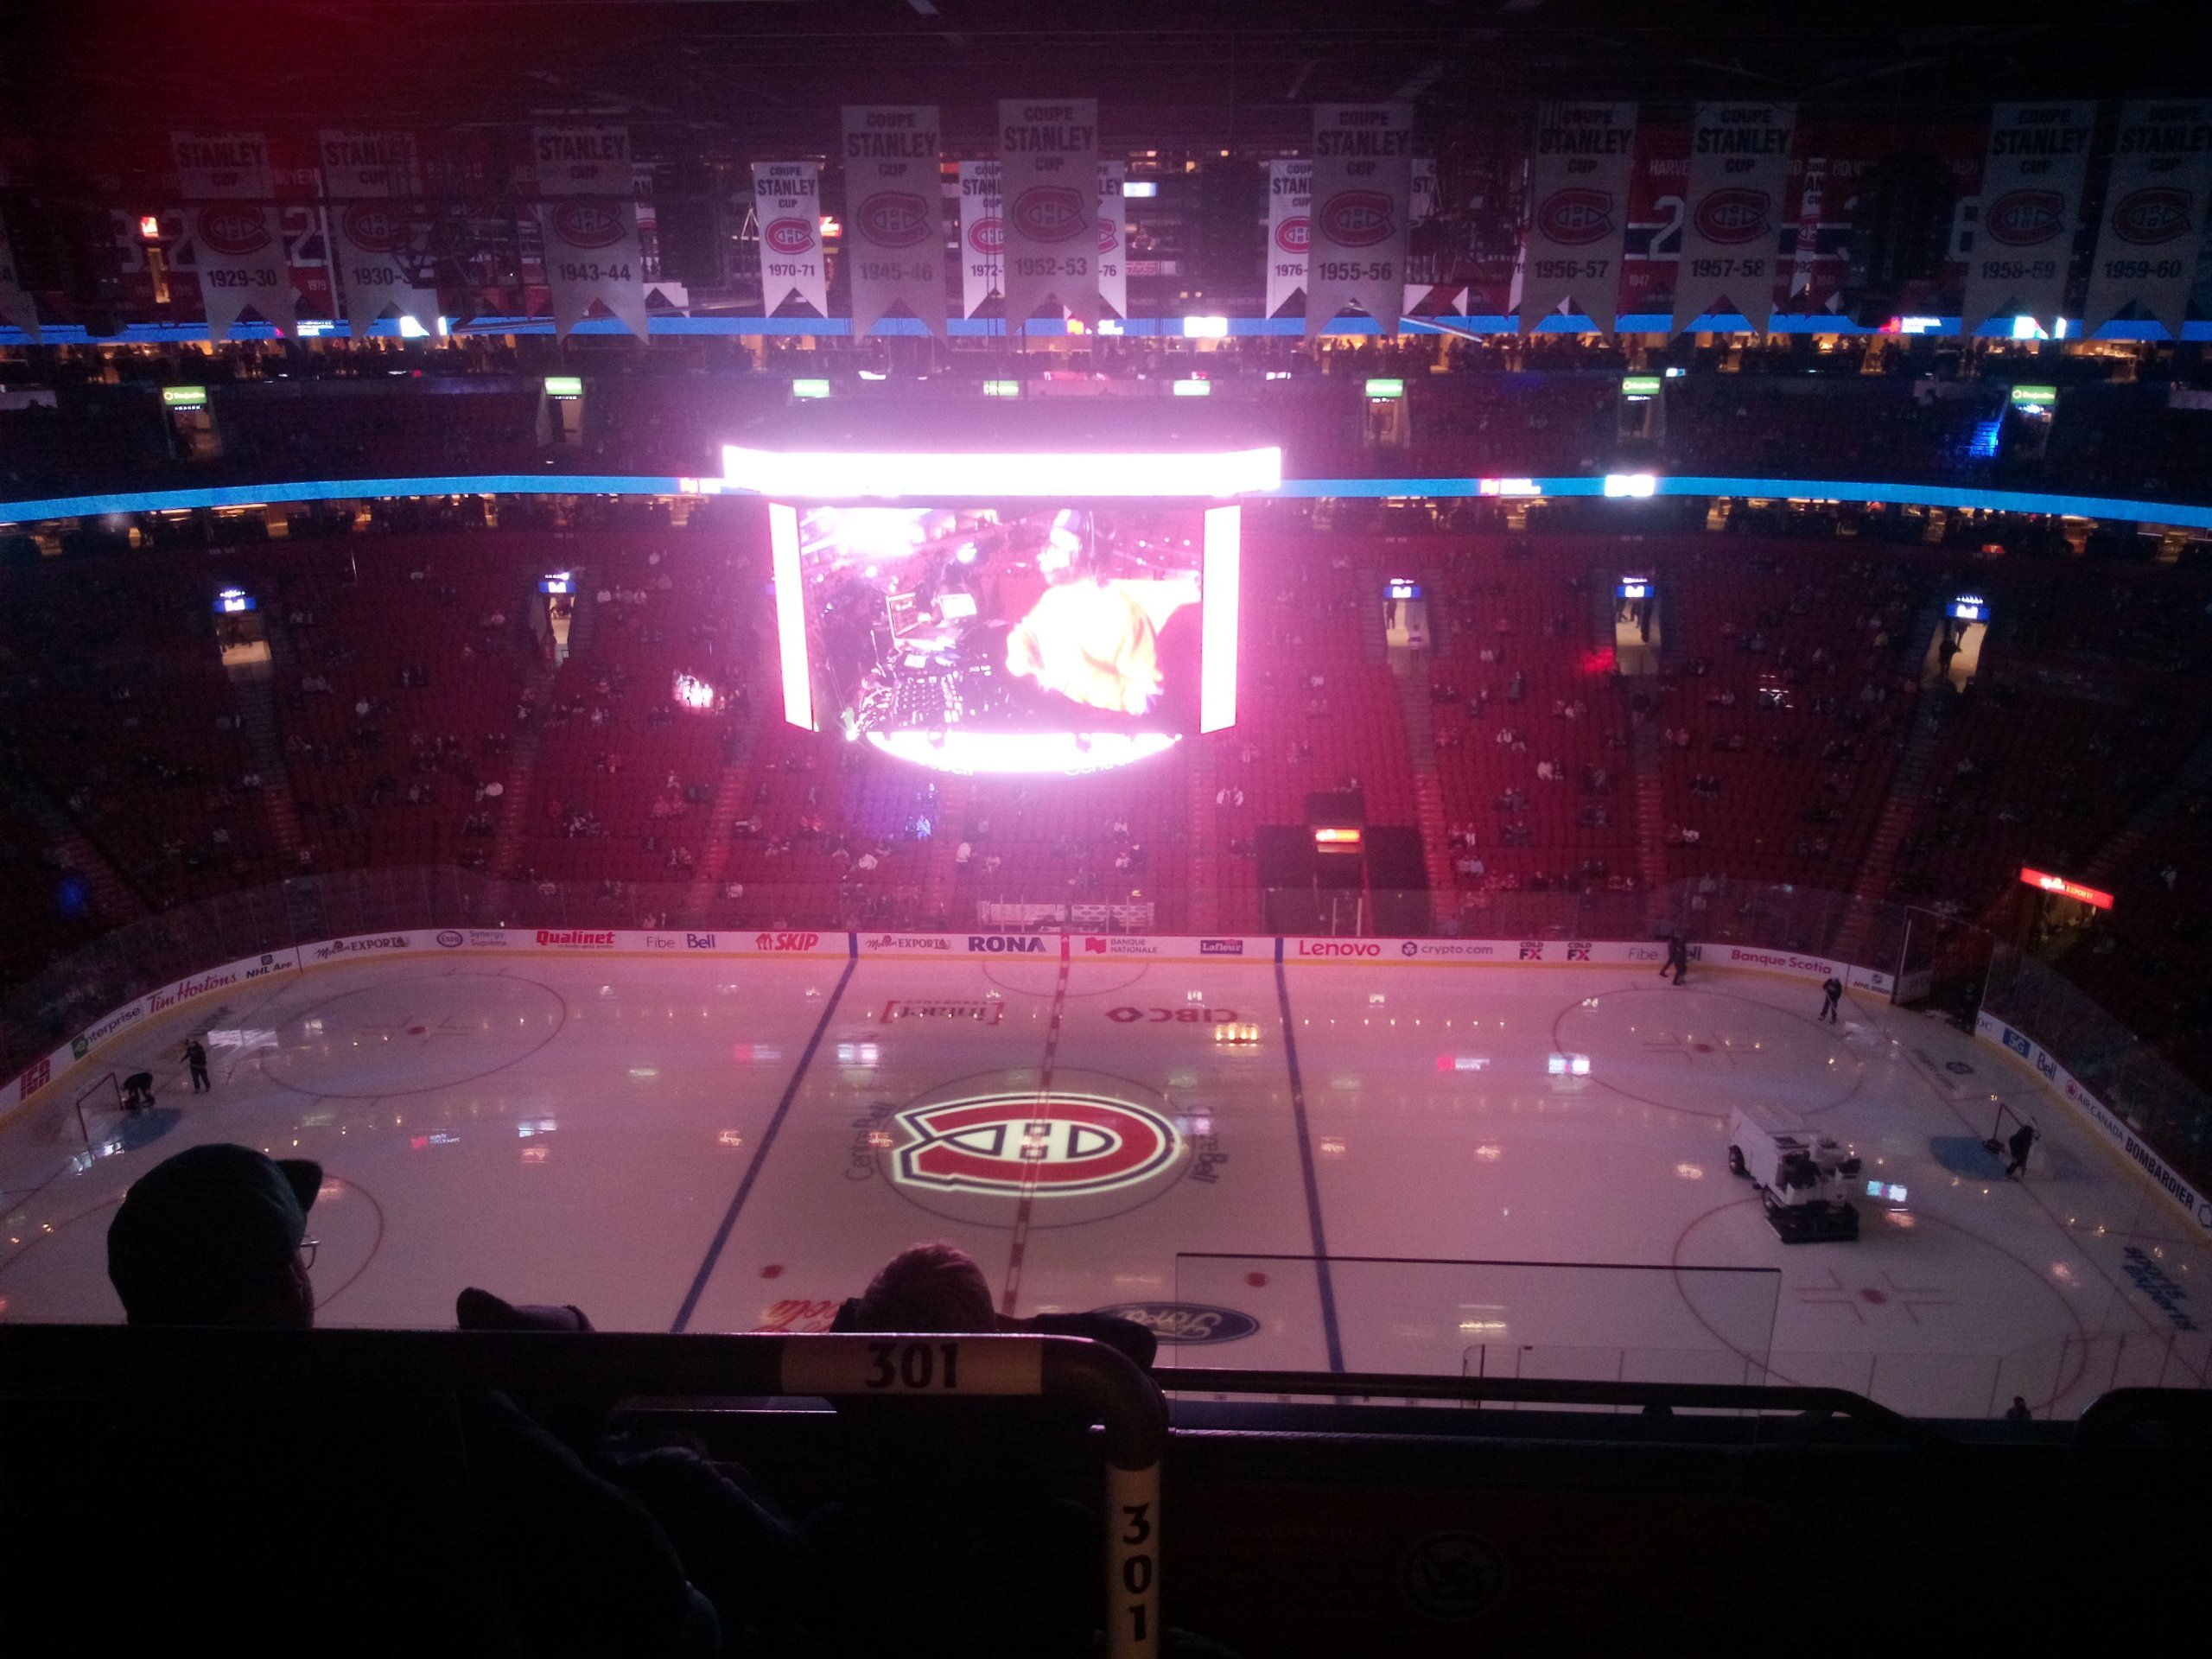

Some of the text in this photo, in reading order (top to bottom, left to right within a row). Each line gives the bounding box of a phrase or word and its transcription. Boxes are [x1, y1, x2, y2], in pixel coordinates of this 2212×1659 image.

[867, 113, 916, 128] COUPE
[1023, 107, 1074, 123] COUPE
[1339, 111, 1389, 126] COUPE
[846, 132, 937, 158] STANLEY
[1004, 126, 1095, 152] STANLEY
[1316, 130, 1408, 156] STANLEY
[1538, 129, 1632, 155] STANLEY
[1696, 128, 1787, 154] STANLEY
[1993, 129, 2089, 156] STANLEY
[537, 136, 626, 161] STANLEY
[769, 166, 803, 176] COUPE
[878, 163, 907, 176] CUP
[1035, 157, 1065, 171] CUP
[1347, 162, 1376, 175] CUP
[1726, 158, 1755, 172] CUP
[757, 179, 816, 196] STANLEY
[779, 199, 798, 208] CUP
[1649, 194, 1685, 262] 2
[558, 264, 632, 282] 1943-44
[768, 264, 815, 276] 1970-71
[1016, 258, 1088, 276] 1952-53
[1319, 262, 1392, 282] 1955-56
[1535, 260, 1609, 279] 1956-57
[1690, 259, 1765, 277] 1957-58
[1981, 261, 2056, 279] 1958-59
[2104, 261, 2183, 279] 1959-60
[207, 270, 278, 288] 1929-30
[351, 937, 400, 951] EXPORT
[469, 931, 505, 940] Synergy
[537, 931, 614, 946] Qualinet
[646, 933, 716, 950] Fibe Bell
[775, 933, 819, 950] SKIP
[899, 938, 939, 949] EXPORT
[968, 936, 1046, 952] RONA
[1202, 942, 1242, 951] Lafleur
[1299, 940, 1381, 957] Lenovo
[1421, 944, 1493, 955] crypto.com
[1519, 949, 1542, 961] FX
[1567, 949, 1591, 961] FX
[1628, 945, 1702, 962] Fibe ell
[1731, 949, 1833, 976] Banque Scotia
[246, 968, 270, 979] NHL
[147, 973, 238, 1014] Tim Hortons
[1853, 980, 1871, 990] NHL
[1149, 1008, 1239, 1023] CIBC
[2006, 1033, 2026, 1052] 5G
[2037, 1052, 2058, 1081] Bell
[2076, 1093, 2124, 1141] AIR CANADA
[2125, 1136, 2195, 1210] BOMBARDIER
[865, 1342, 959, 1389] 301
[1122, 1502, 1154, 1642] 301
